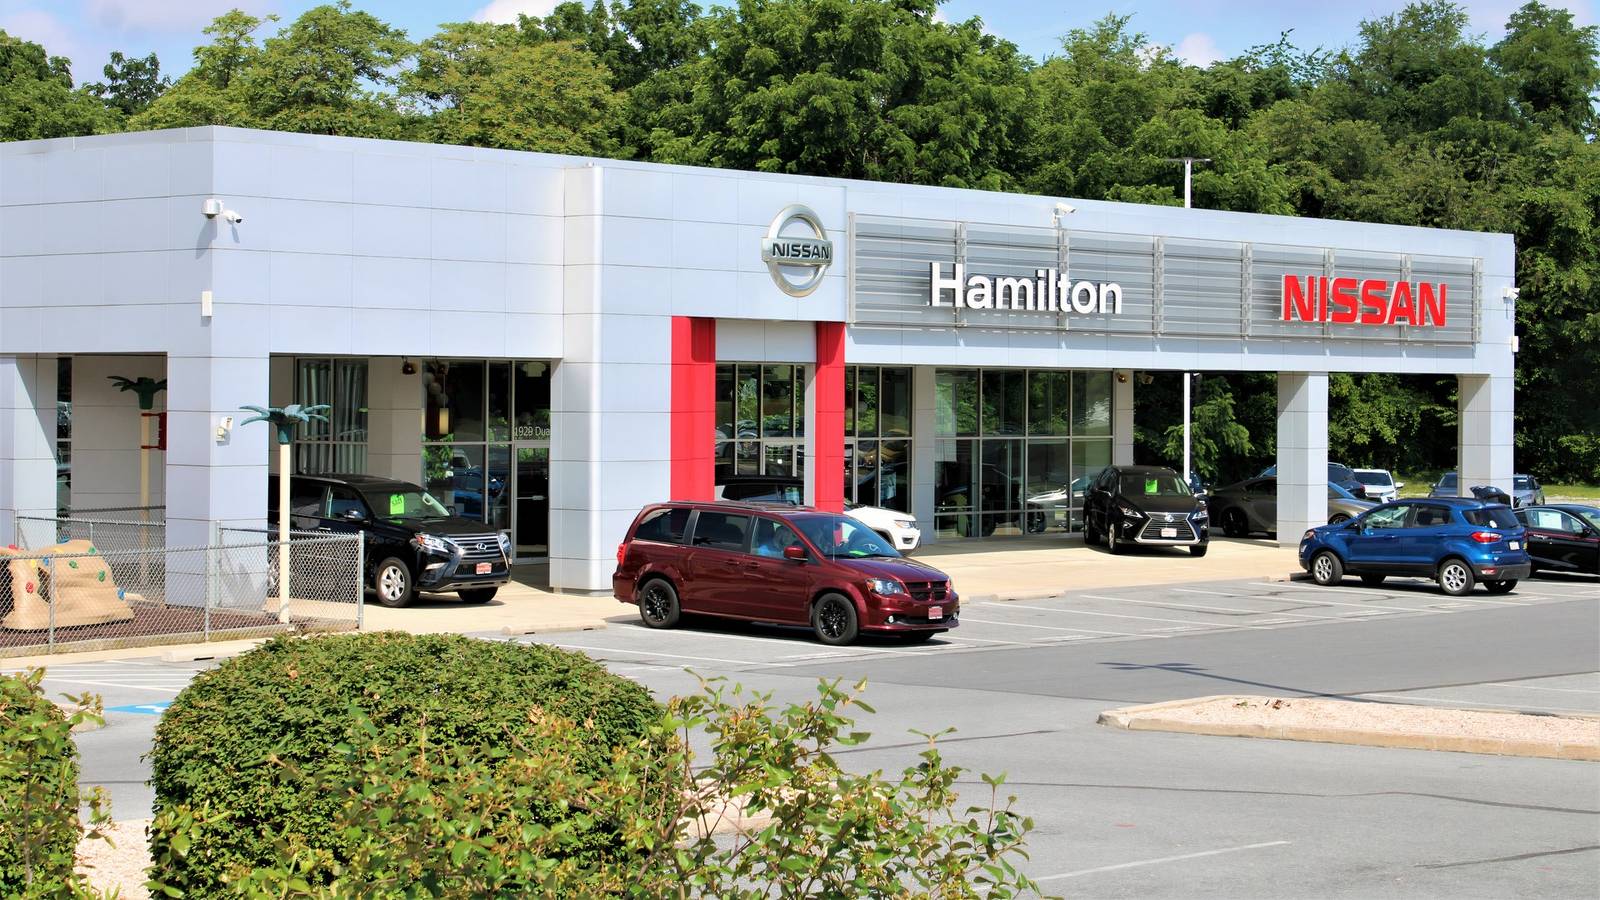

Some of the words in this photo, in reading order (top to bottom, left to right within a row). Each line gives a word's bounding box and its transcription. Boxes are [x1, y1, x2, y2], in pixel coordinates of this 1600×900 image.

[772, 242, 832, 260] NISSAN
[930, 262, 1123, 314] Hamilton
[1281, 274, 1447, 327] NISSAN
